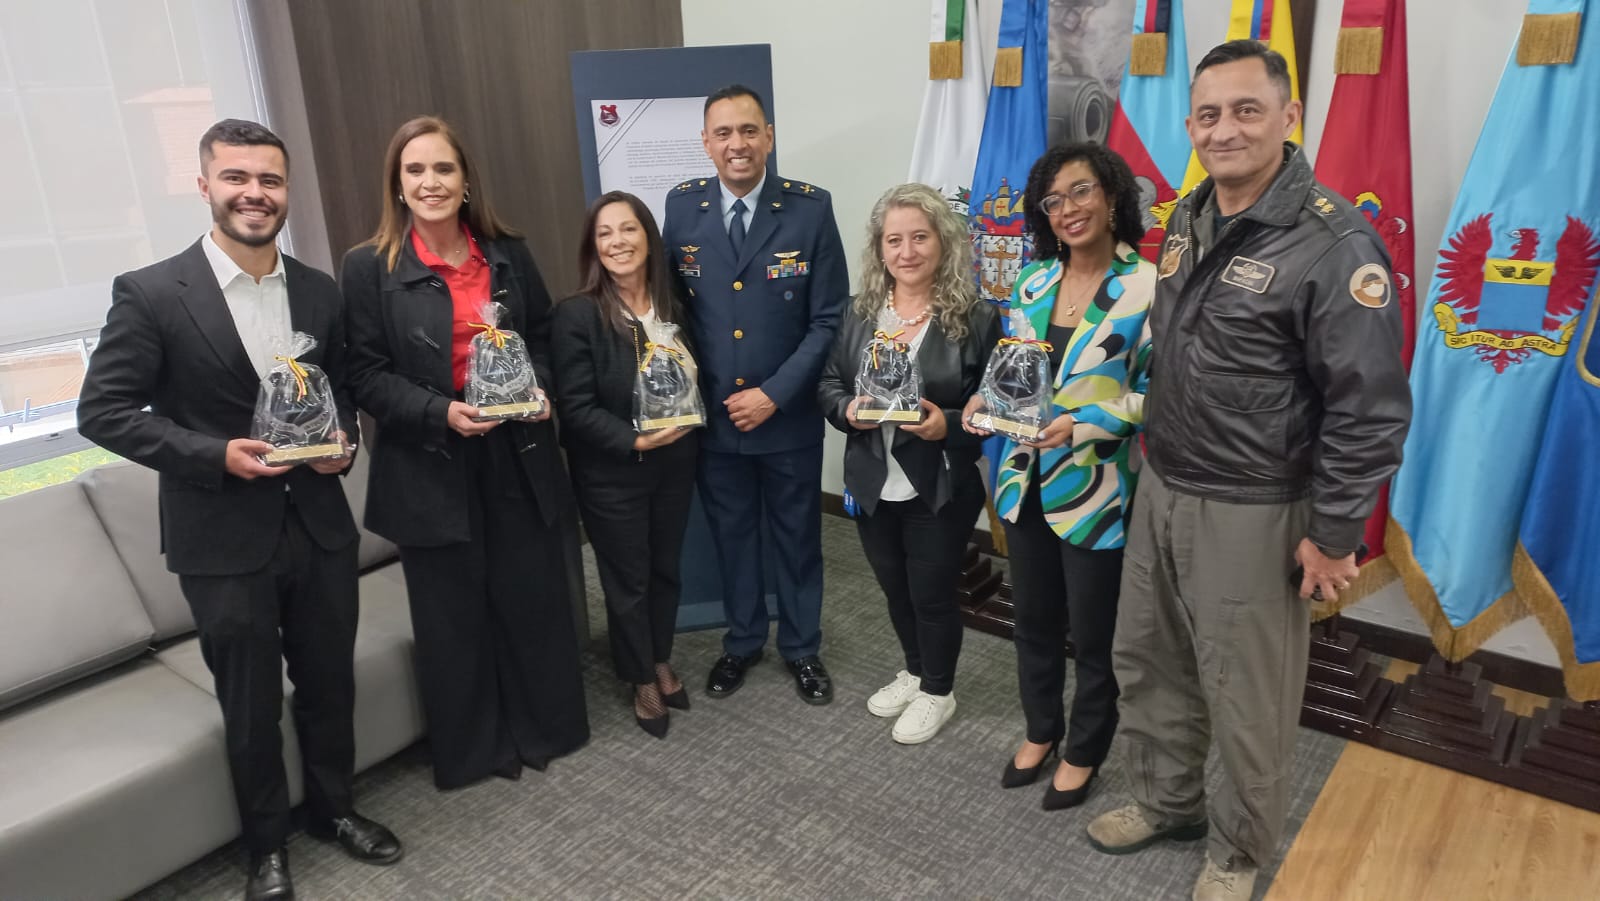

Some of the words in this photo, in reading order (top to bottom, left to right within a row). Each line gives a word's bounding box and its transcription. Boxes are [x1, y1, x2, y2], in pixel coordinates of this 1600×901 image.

[1450, 336, 1467, 346] SIC
[1471, 334, 1495, 344] ITUR
[1499, 340, 1515, 348] AD
[1521, 338, 1556, 351] ASTRA
